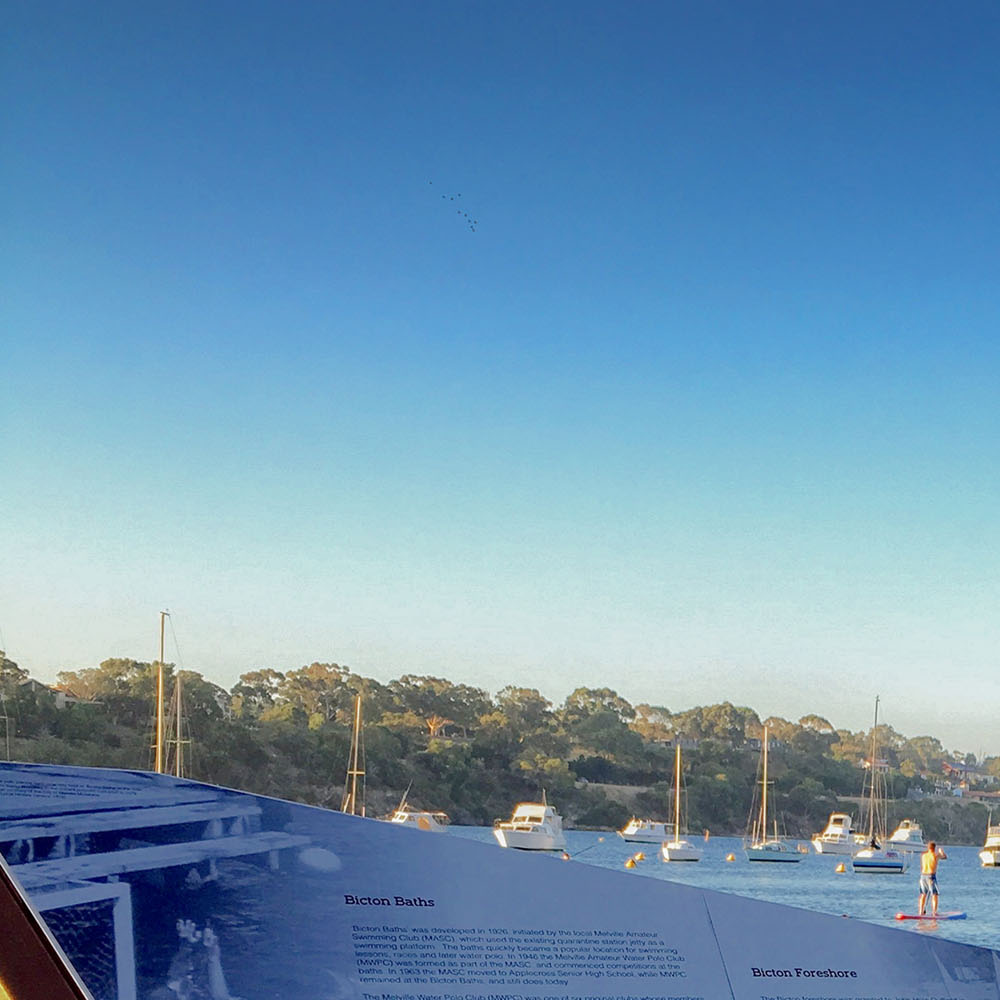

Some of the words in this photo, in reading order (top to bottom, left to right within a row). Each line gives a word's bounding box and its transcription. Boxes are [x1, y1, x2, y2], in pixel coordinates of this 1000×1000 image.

[344, 895, 391, 906] Bicton
[394, 896, 435, 907] Baths
[751, 967, 792, 978] Bicton
[794, 968, 858, 978] Foreshore
